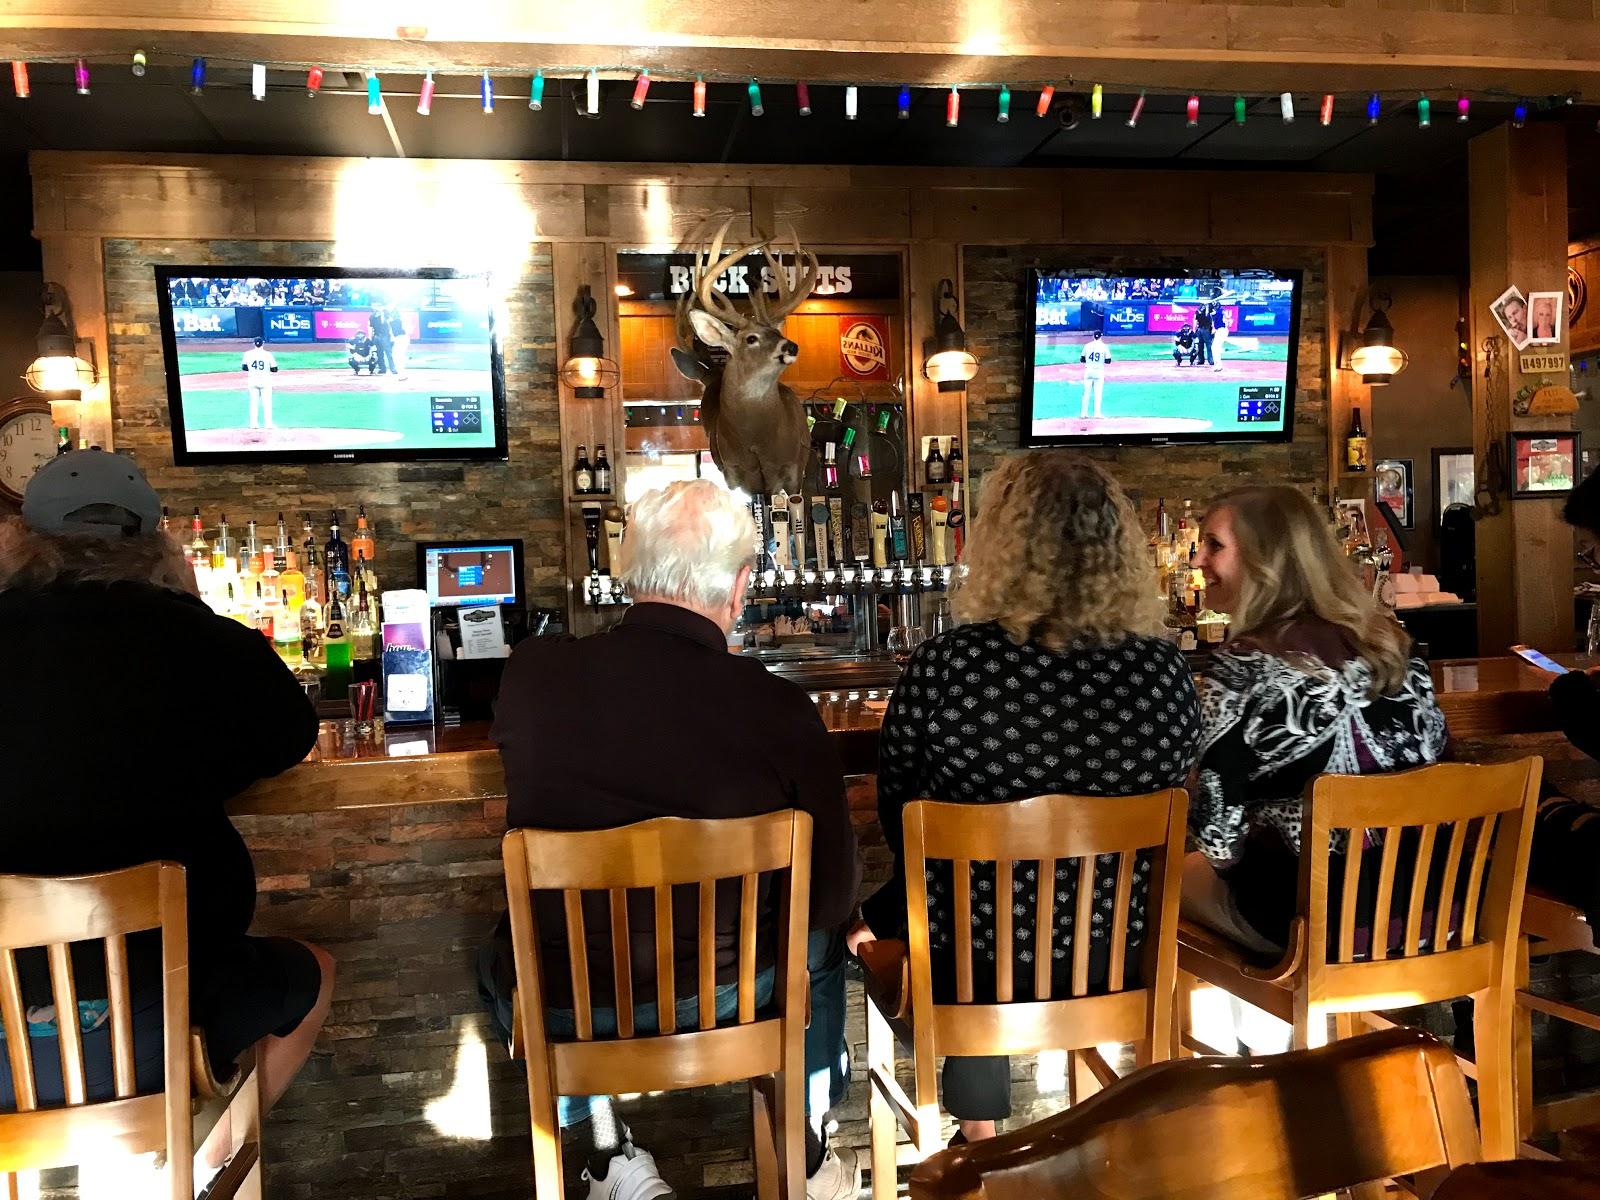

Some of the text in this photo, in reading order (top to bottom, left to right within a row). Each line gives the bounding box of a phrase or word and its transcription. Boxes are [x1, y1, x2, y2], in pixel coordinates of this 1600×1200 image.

[760, 265, 853, 294] SHTS
[270, 319, 311, 330] NLDS
[1109, 313, 1145, 323] NLDS
[1088, 351, 1101, 362] 49
[251, 359, 265, 371] 49
[15, 423, 25, 436] 11
[31, 417, 42, 431] 12
[3, 434, 13, 447] 10
[5, 465, 13, 479] 8
[753, 502, 764, 532] LIGHT
